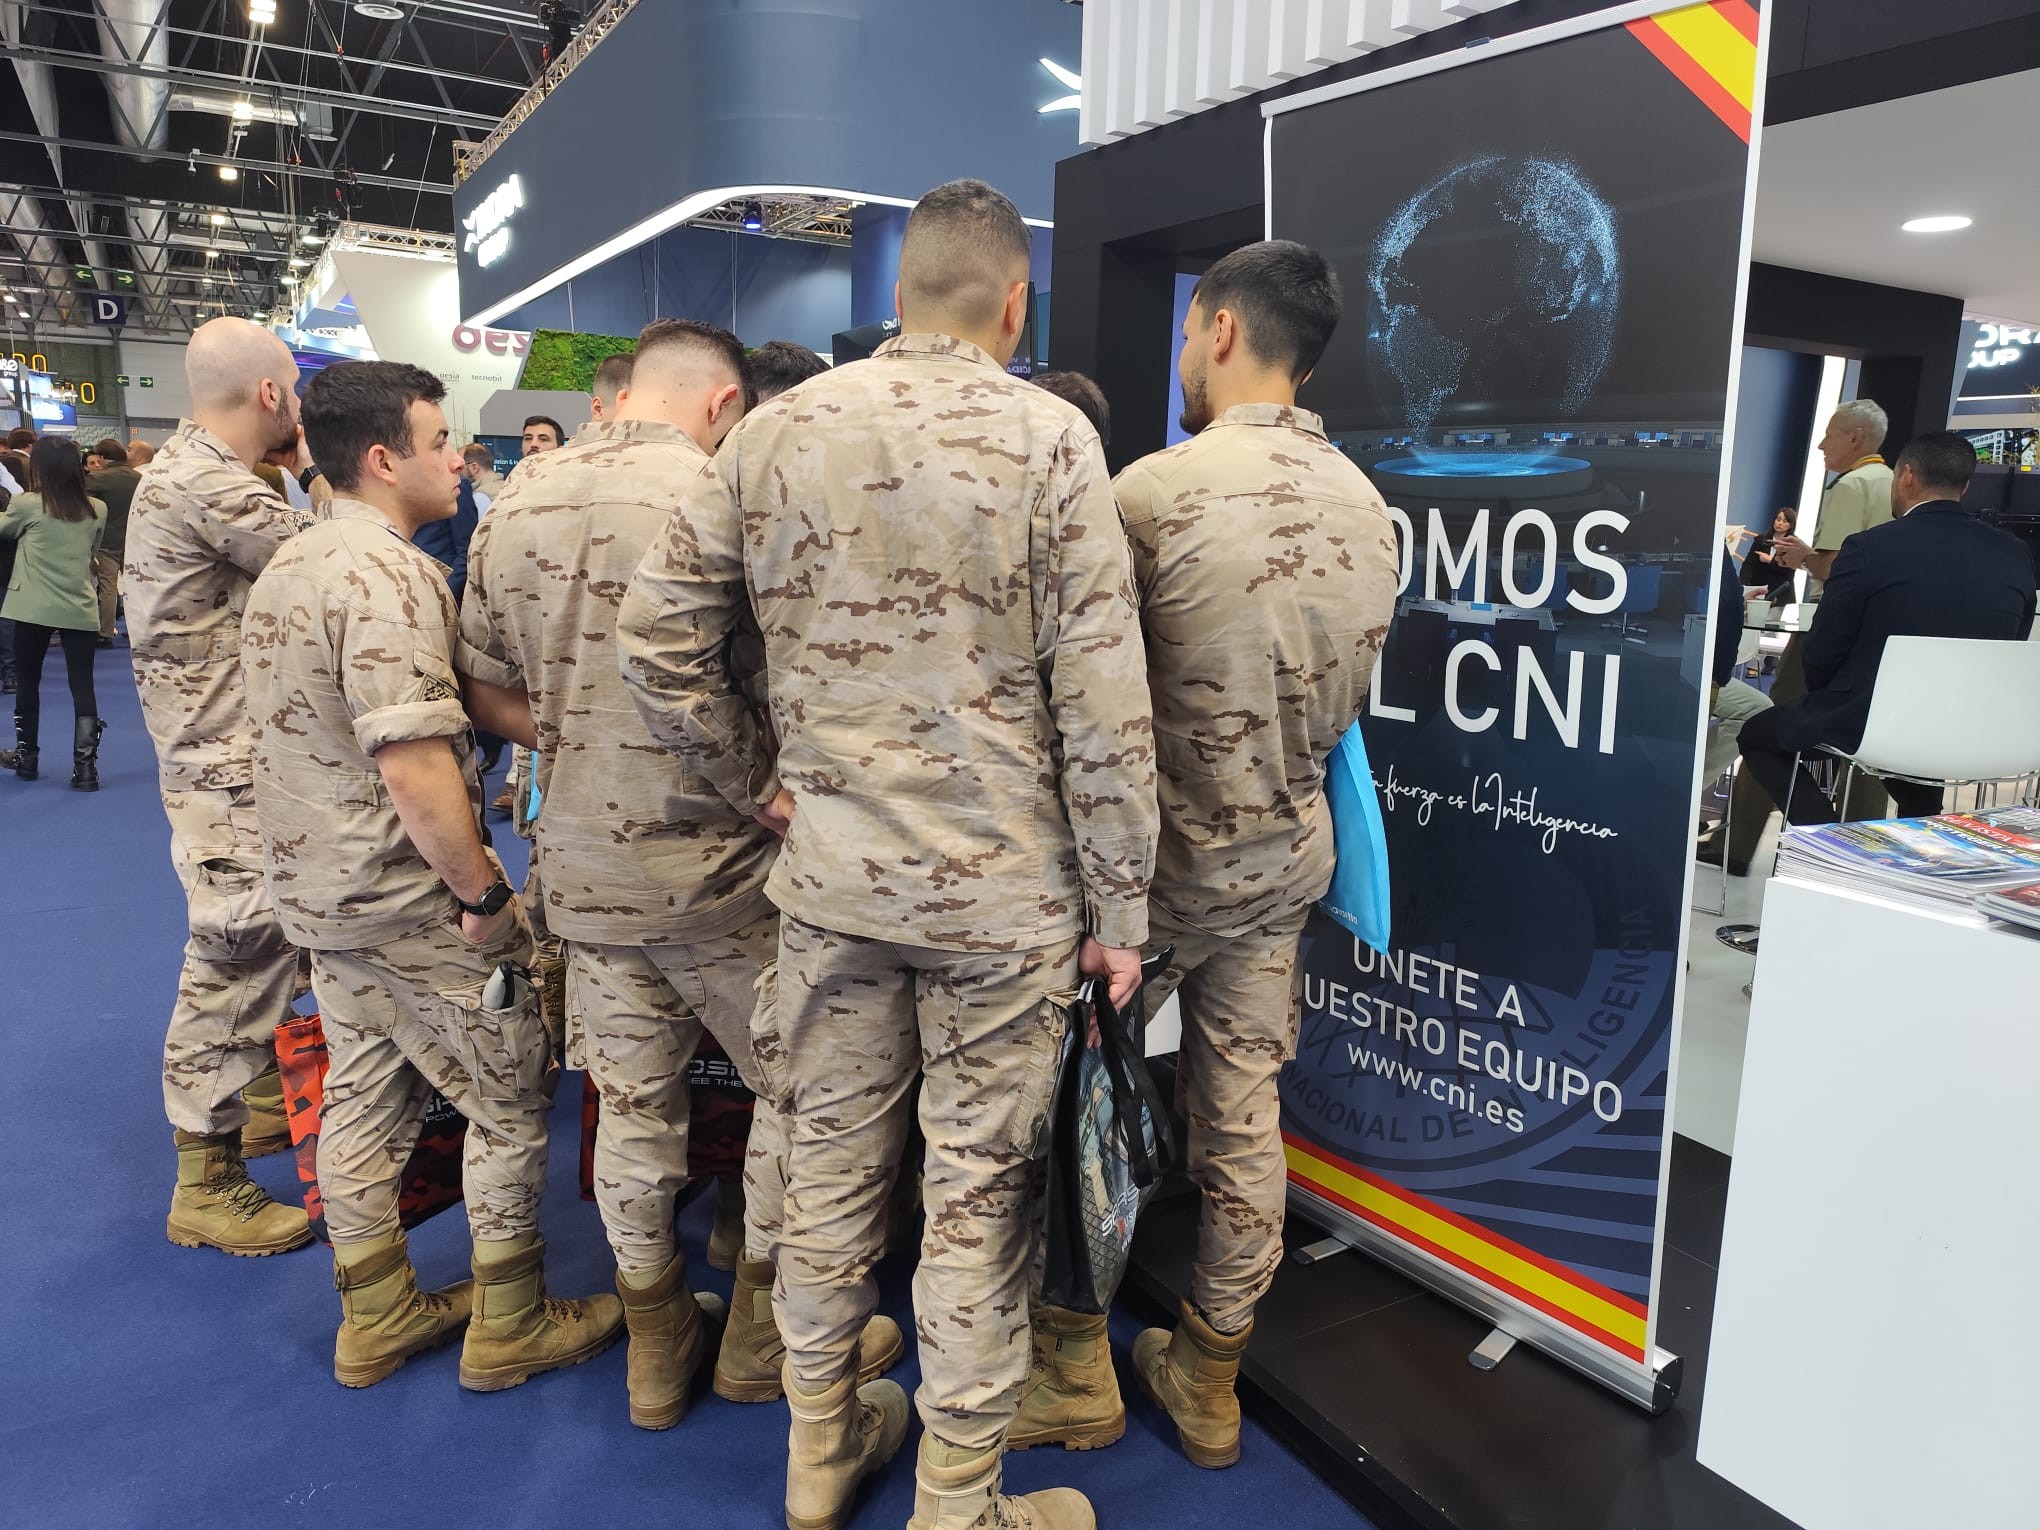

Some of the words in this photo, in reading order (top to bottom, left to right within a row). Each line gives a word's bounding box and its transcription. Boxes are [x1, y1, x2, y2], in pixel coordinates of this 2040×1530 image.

[98, 299, 119, 320] D
[1444, 639, 1621, 755] CNI
[1384, 764, 1443, 826] fuerza
[1448, 794, 1468, 809] es
[1496, 984, 1526, 1027] A
[1304, 973, 1446, 1055] UESTRO
[1458, 1029, 1623, 1123] EQUIPO
[1347, 1042, 1525, 1134] www.cni.es
[1422, 1109, 1474, 1143] DE
